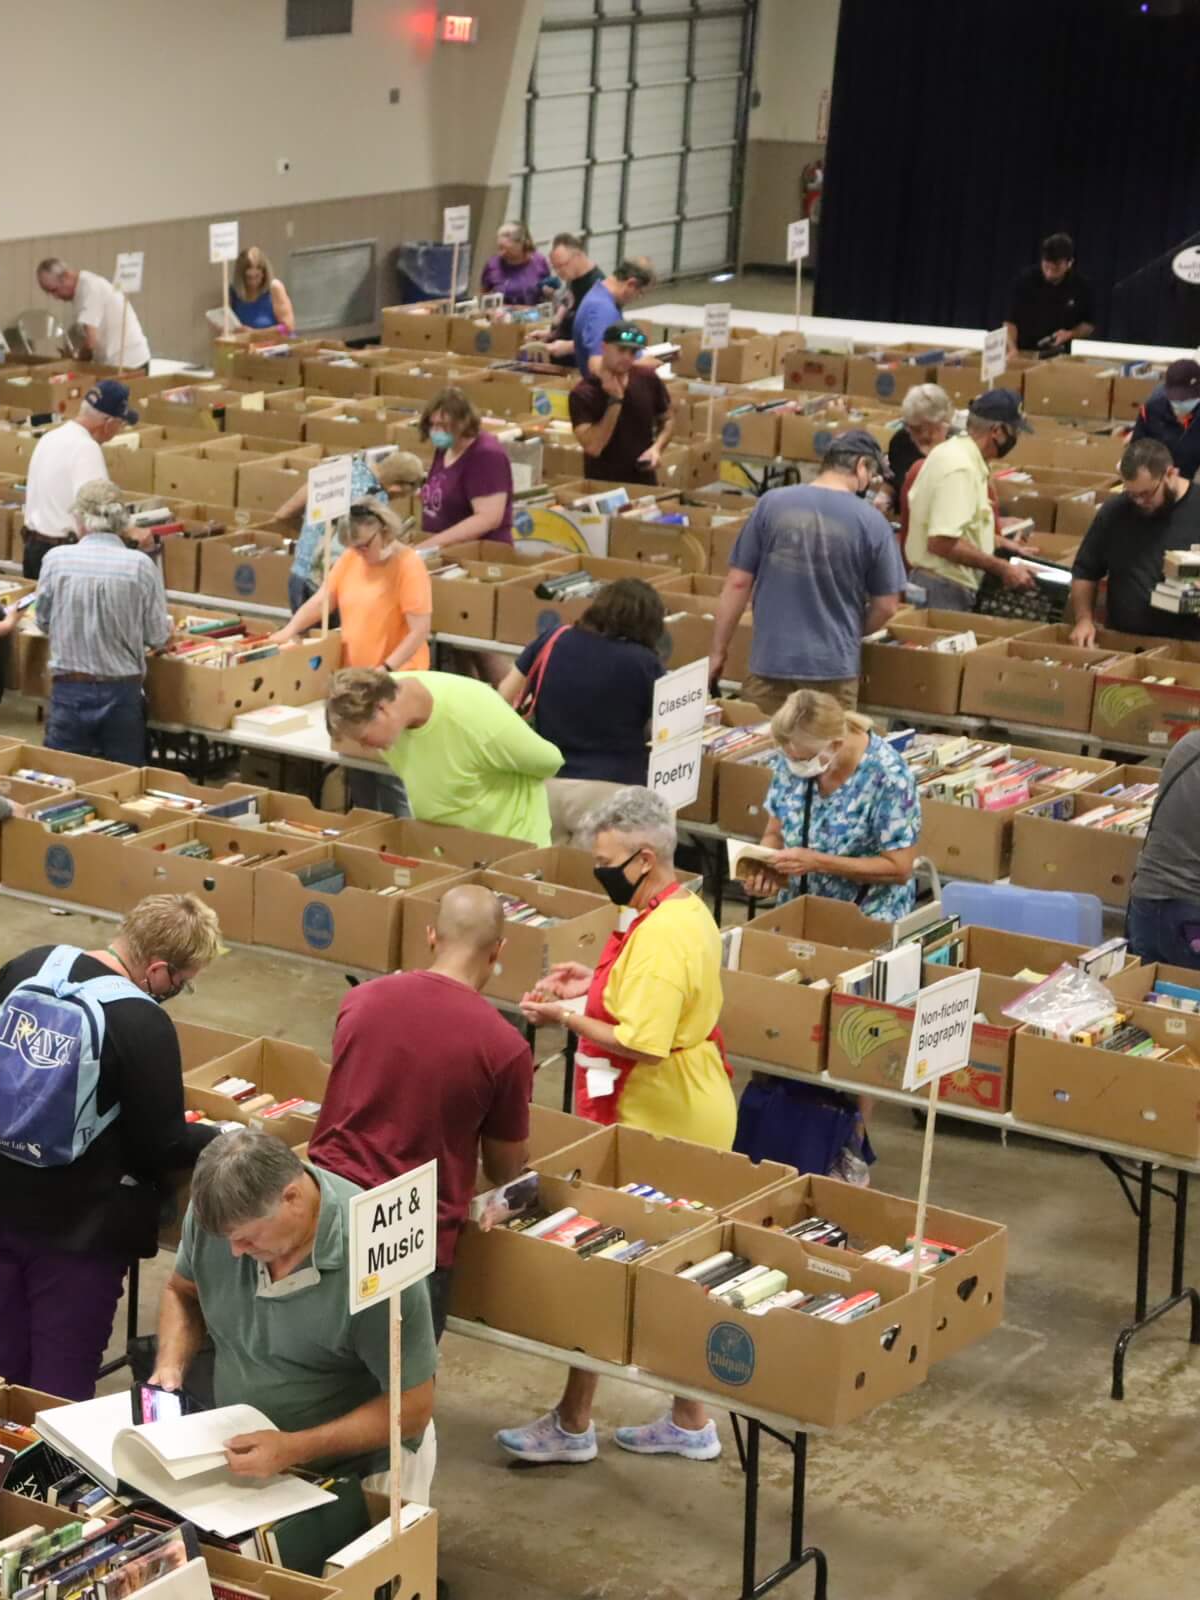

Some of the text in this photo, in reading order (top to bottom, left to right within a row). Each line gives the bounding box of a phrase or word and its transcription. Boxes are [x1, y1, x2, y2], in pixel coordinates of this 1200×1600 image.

[445, 16, 472, 41] EXIT
[315, 487, 345, 503] Cooking
[658, 688, 703, 716] Classics
[654, 760, 696, 788] Poetry
[921, 998, 969, 1026] Non-fiction
[918, 1021, 966, 1051] Biography
[372, 1187, 421, 1233] Art &
[367, 1227, 425, 1274] Music
